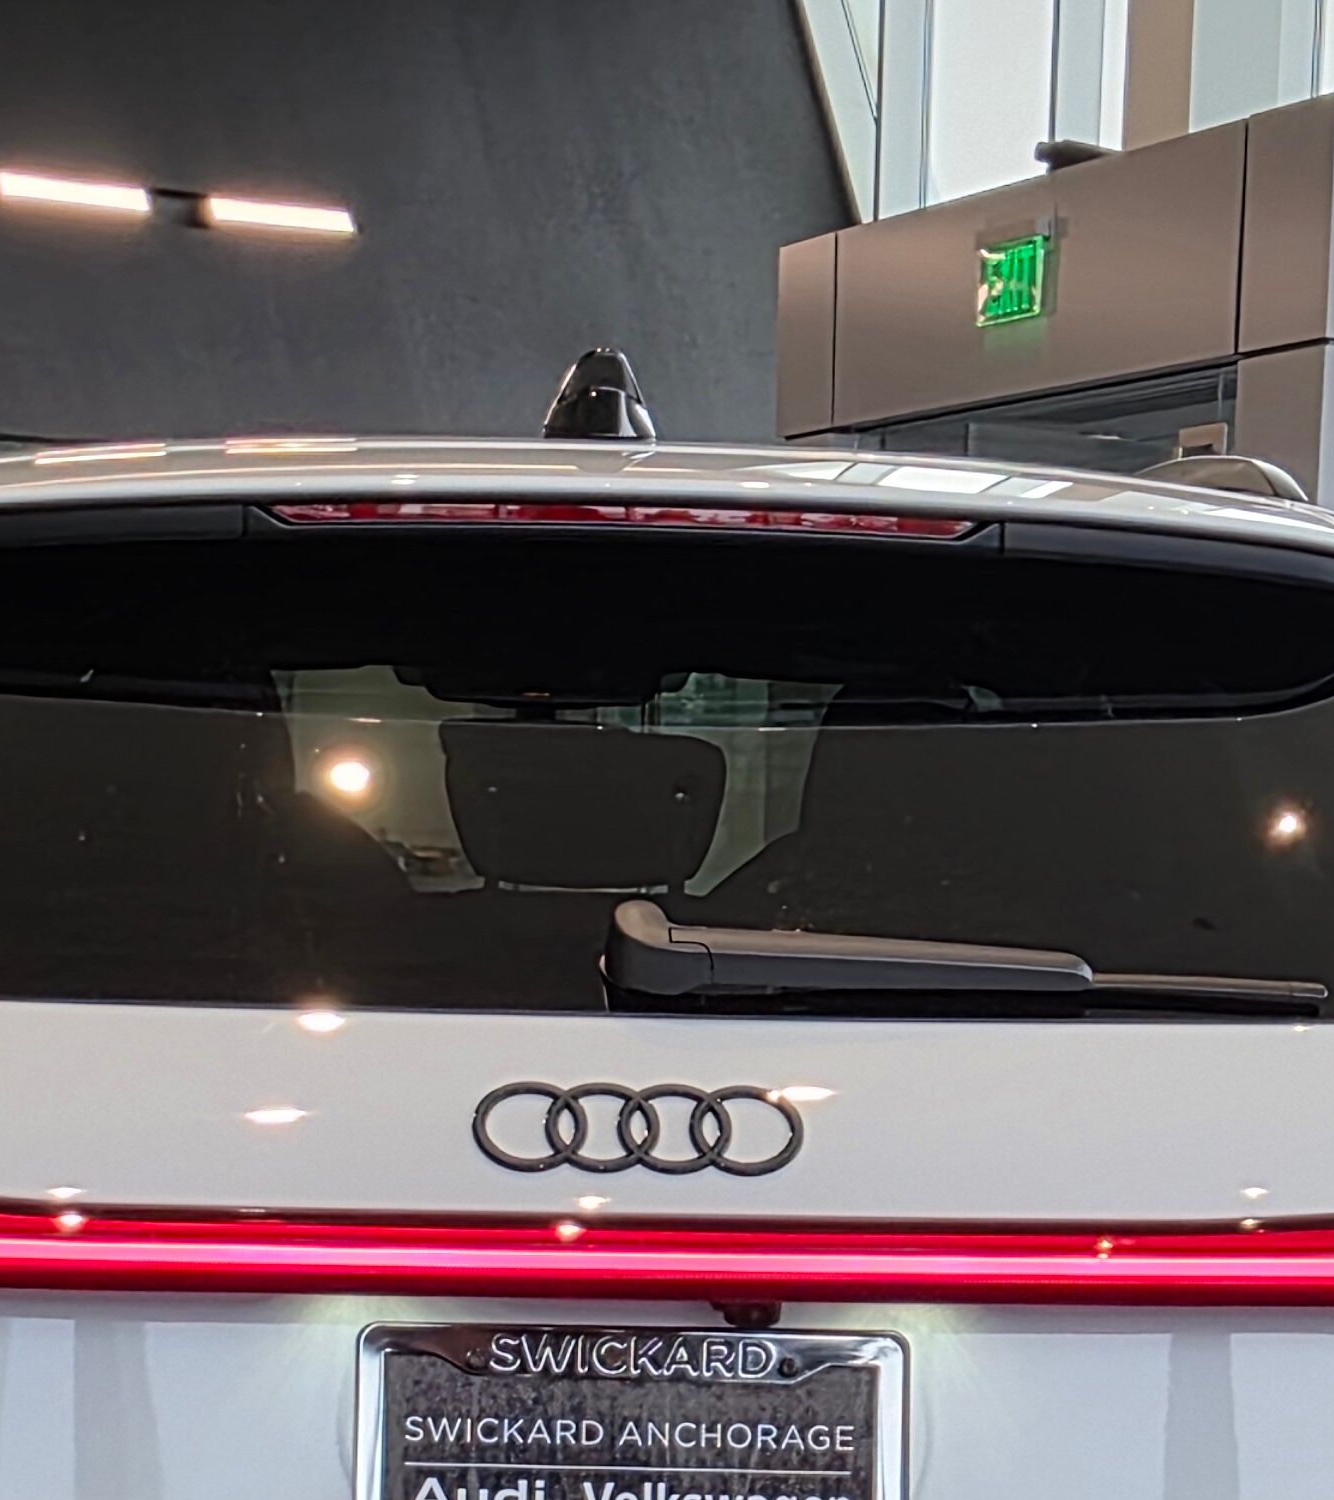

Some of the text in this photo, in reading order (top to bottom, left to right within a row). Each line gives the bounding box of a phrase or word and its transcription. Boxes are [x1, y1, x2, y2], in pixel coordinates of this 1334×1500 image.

[489, 1333, 777, 1379] SWICKARD
[404, 1415, 855, 1452] SWICKARD ANCHORAGE
